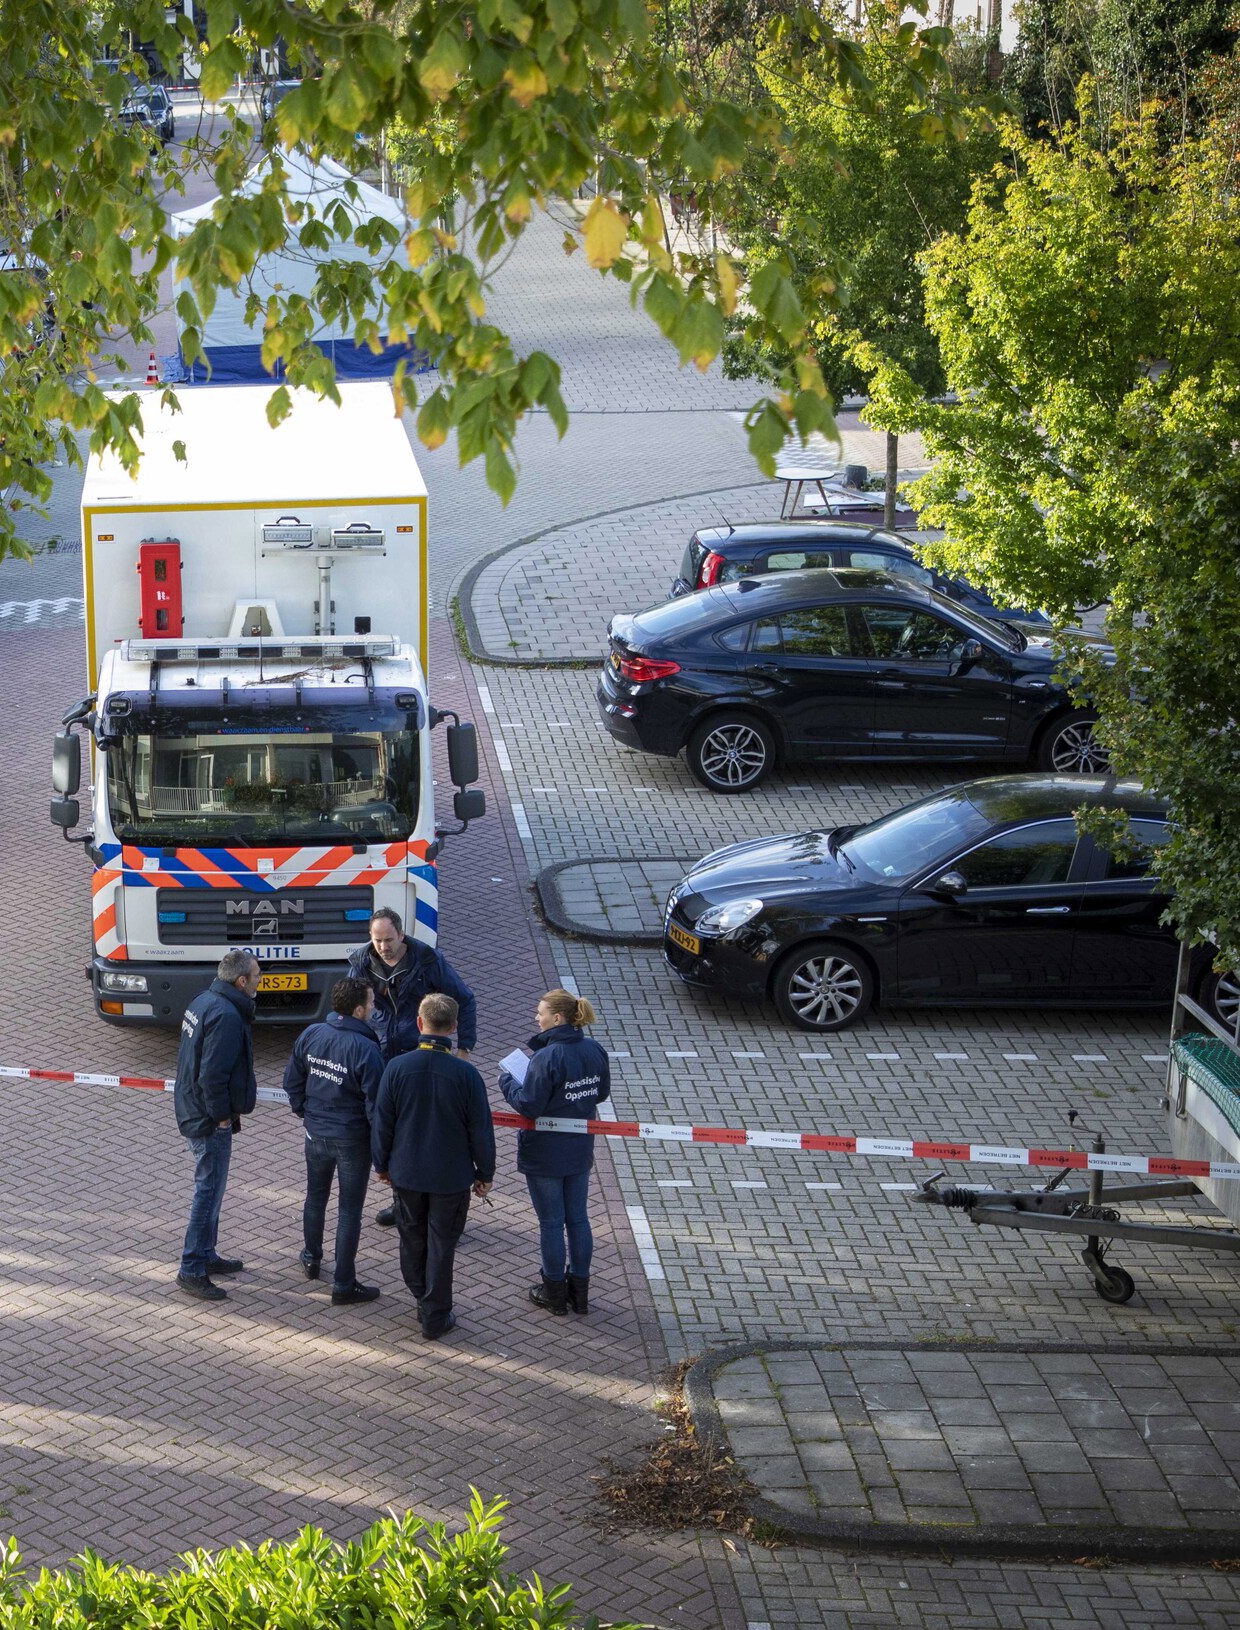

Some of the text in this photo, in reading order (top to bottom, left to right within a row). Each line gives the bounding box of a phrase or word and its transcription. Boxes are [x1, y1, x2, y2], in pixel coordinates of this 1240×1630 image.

[226, 900, 305, 915] MAN
[230, 947, 301, 959] OLITIE
[258, 976, 302, 989] -RS-73
[310, 1066, 344, 1086] psporing
